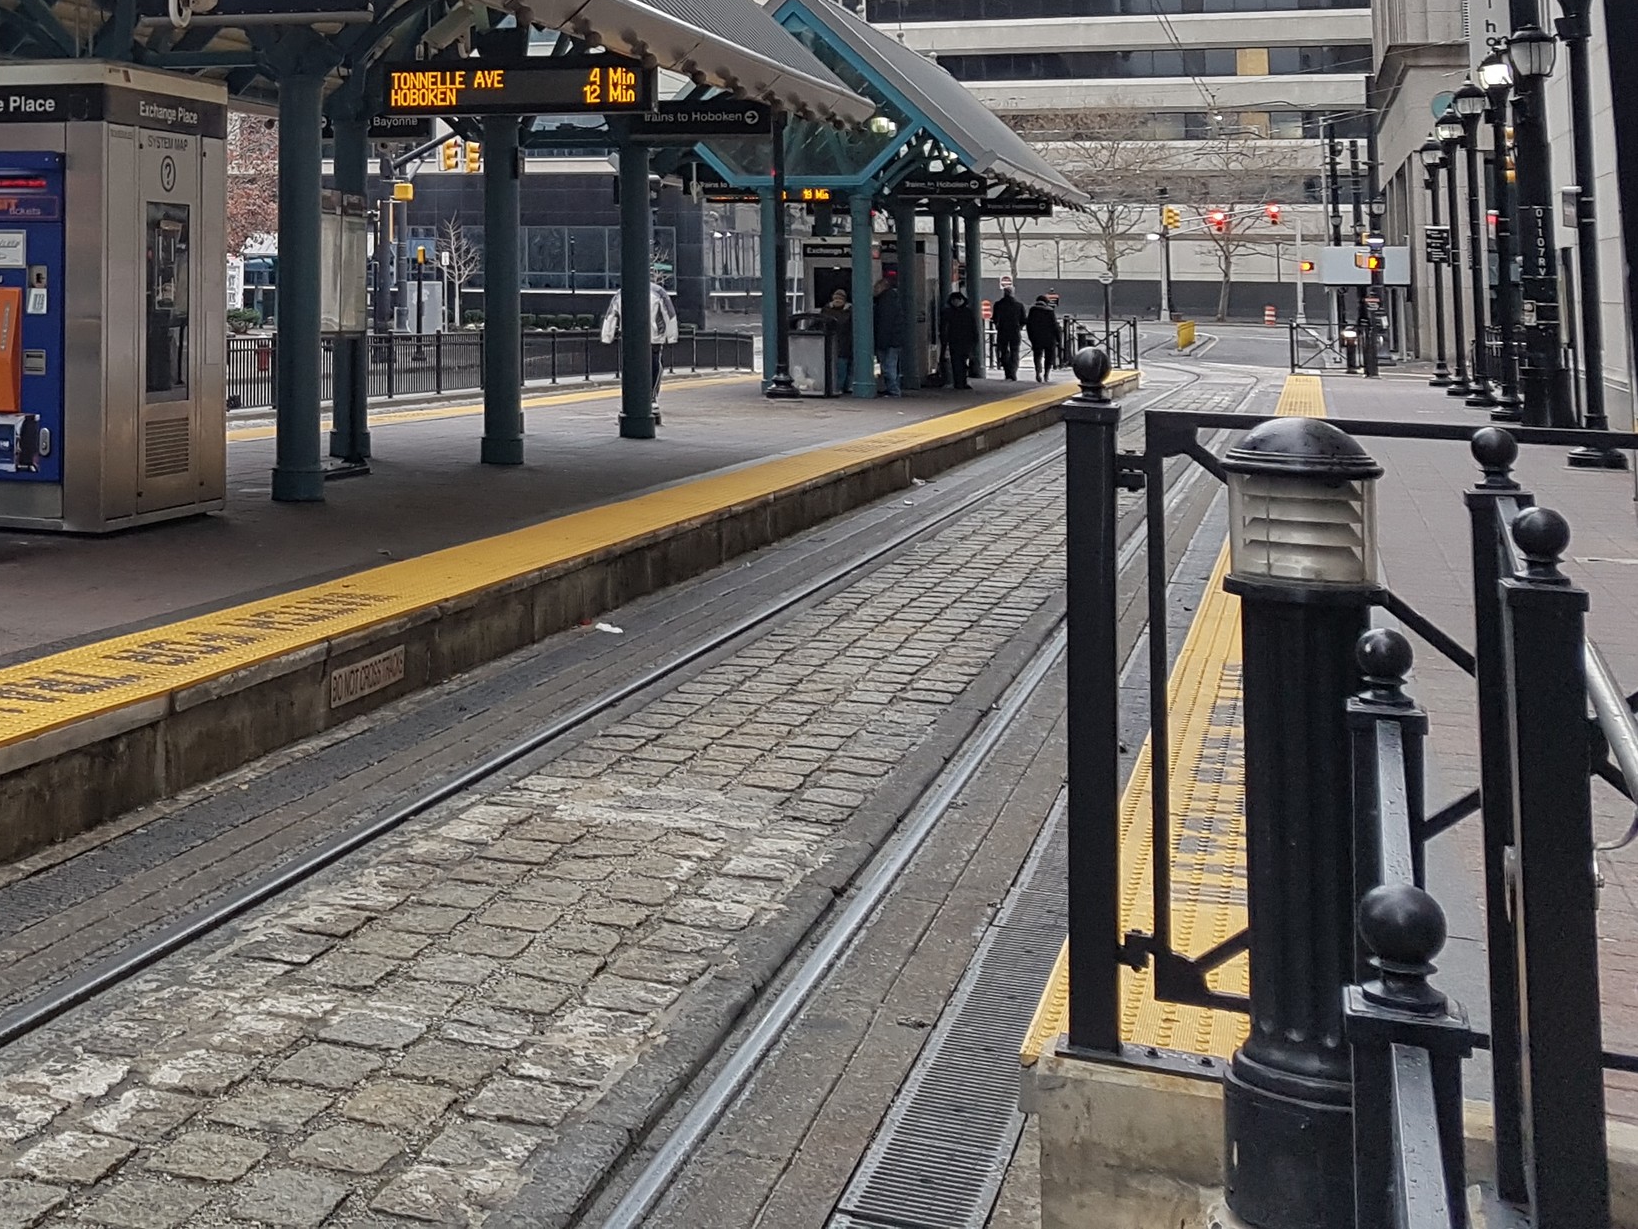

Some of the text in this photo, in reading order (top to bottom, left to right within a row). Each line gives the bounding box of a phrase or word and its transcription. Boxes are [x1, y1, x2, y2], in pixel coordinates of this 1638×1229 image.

[391, 67, 635, 89] TONNELLE AVE 4 Min
[9, 96, 55, 112] Place
[391, 85, 635, 106] HOBOKEN 12 Min
[139, 100, 198, 124] Exchange Place
[373, 115, 418, 128] Bayonne
[677, 112, 689, 122] to
[691, 111, 742, 122] Hoboken
[147, 134, 189, 151] SYSTEM MAP
[101, 629, 266, 667] FOR
